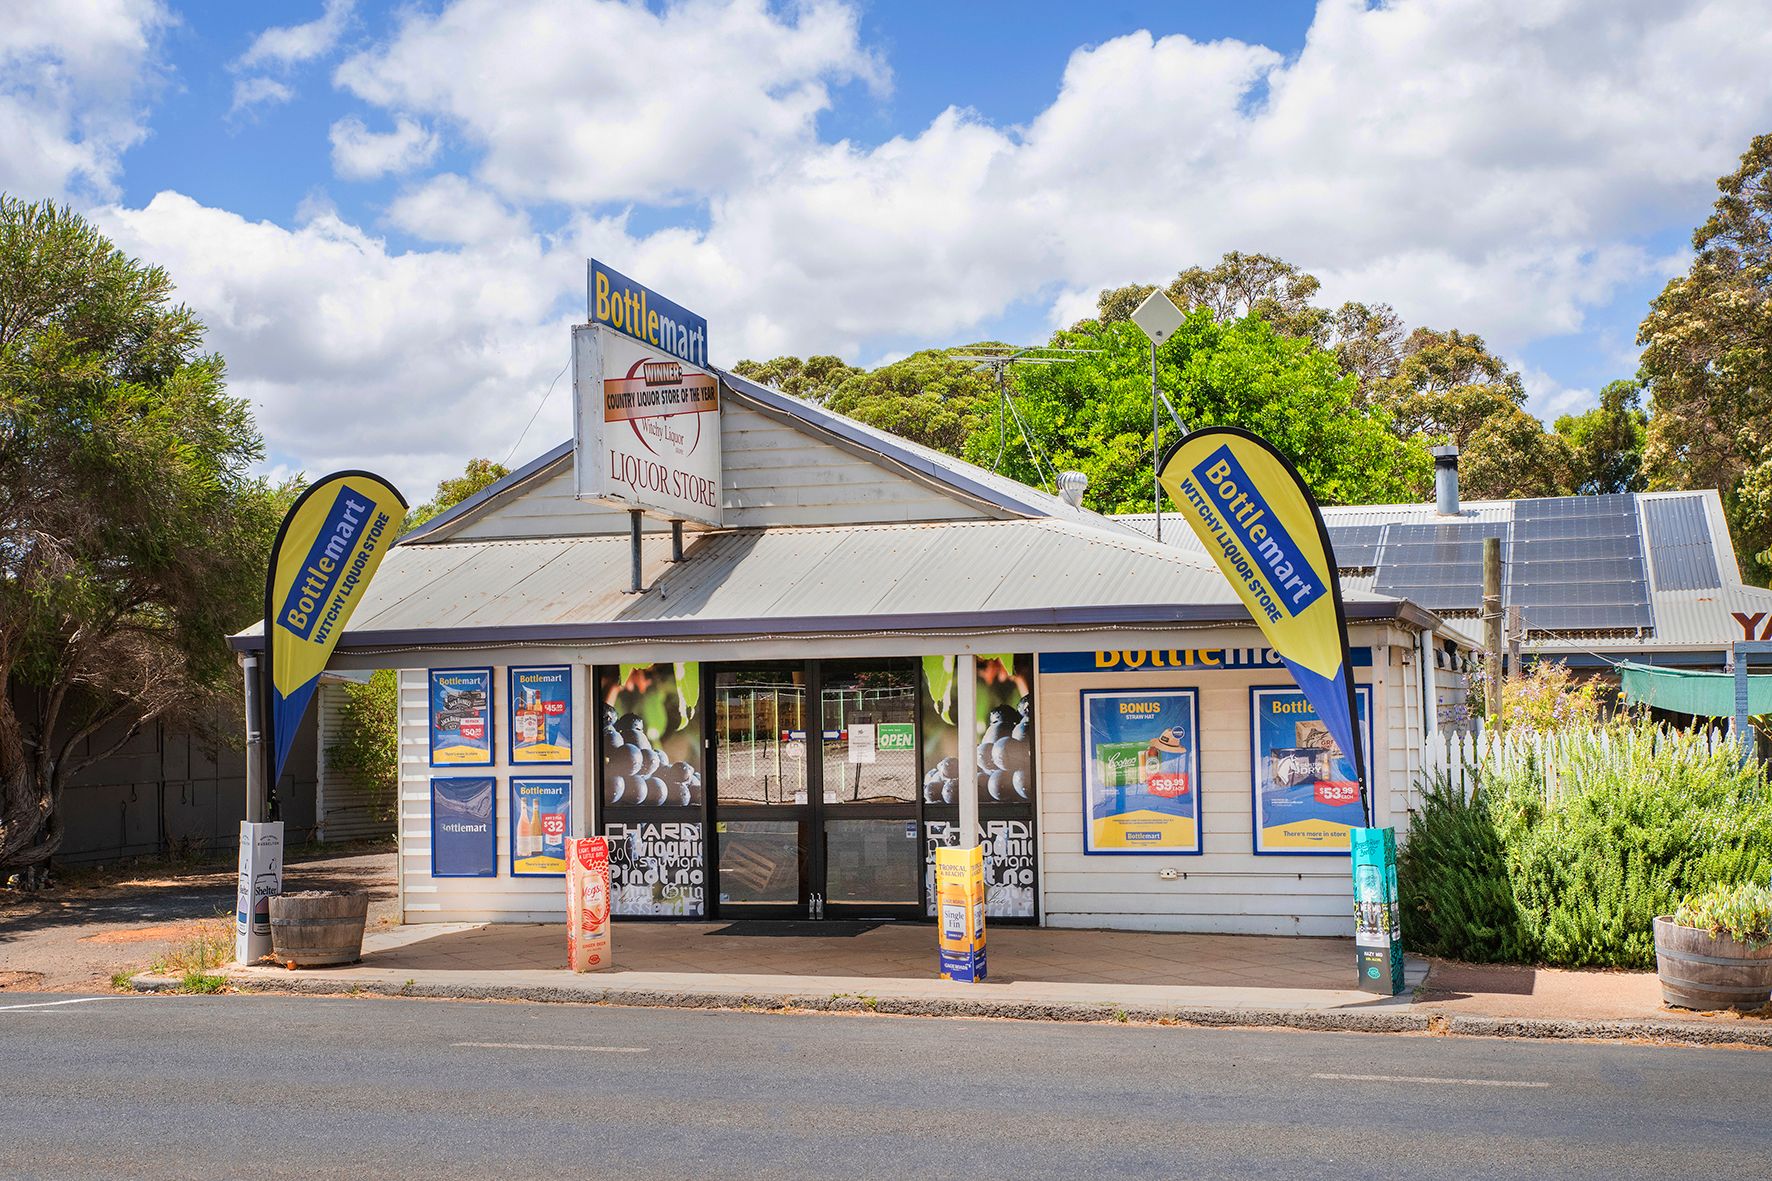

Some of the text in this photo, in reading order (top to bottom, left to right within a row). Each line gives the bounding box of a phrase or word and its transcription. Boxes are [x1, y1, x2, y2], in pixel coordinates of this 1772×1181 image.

[595, 271, 705, 368] Bottlemart
[607, 386, 715, 410] COUNTRY LIQUOR STORE OF THE YEAR
[664, 425, 684, 446] Liquor
[610, 450, 717, 507] LIQUOR STORE
[1205, 458, 1313, 604] Bottlemart
[1179, 477, 1283, 624] WITCHY LIQUOR STORE
[287, 499, 366, 631] Bottlemart
[313, 512, 390, 645] WITCHY LIQUOR STORE
[439, 677, 481, 685] Bottlemart
[519, 674, 562, 683] Bottlemart
[1119, 702, 1161, 714] BONUS
[880, 733, 912, 747] OPEN
[1301, 766, 1321, 775] DRY
[520, 787, 562, 795] Bottlemart
[543, 820, 563, 832] $32
[938, 863, 967, 871] TROPICAL
[609, 864, 669, 885] Pinot
[255, 885, 277, 896] Shelter
[945, 911, 965, 921] Single
[949, 920, 961, 928] Fin
